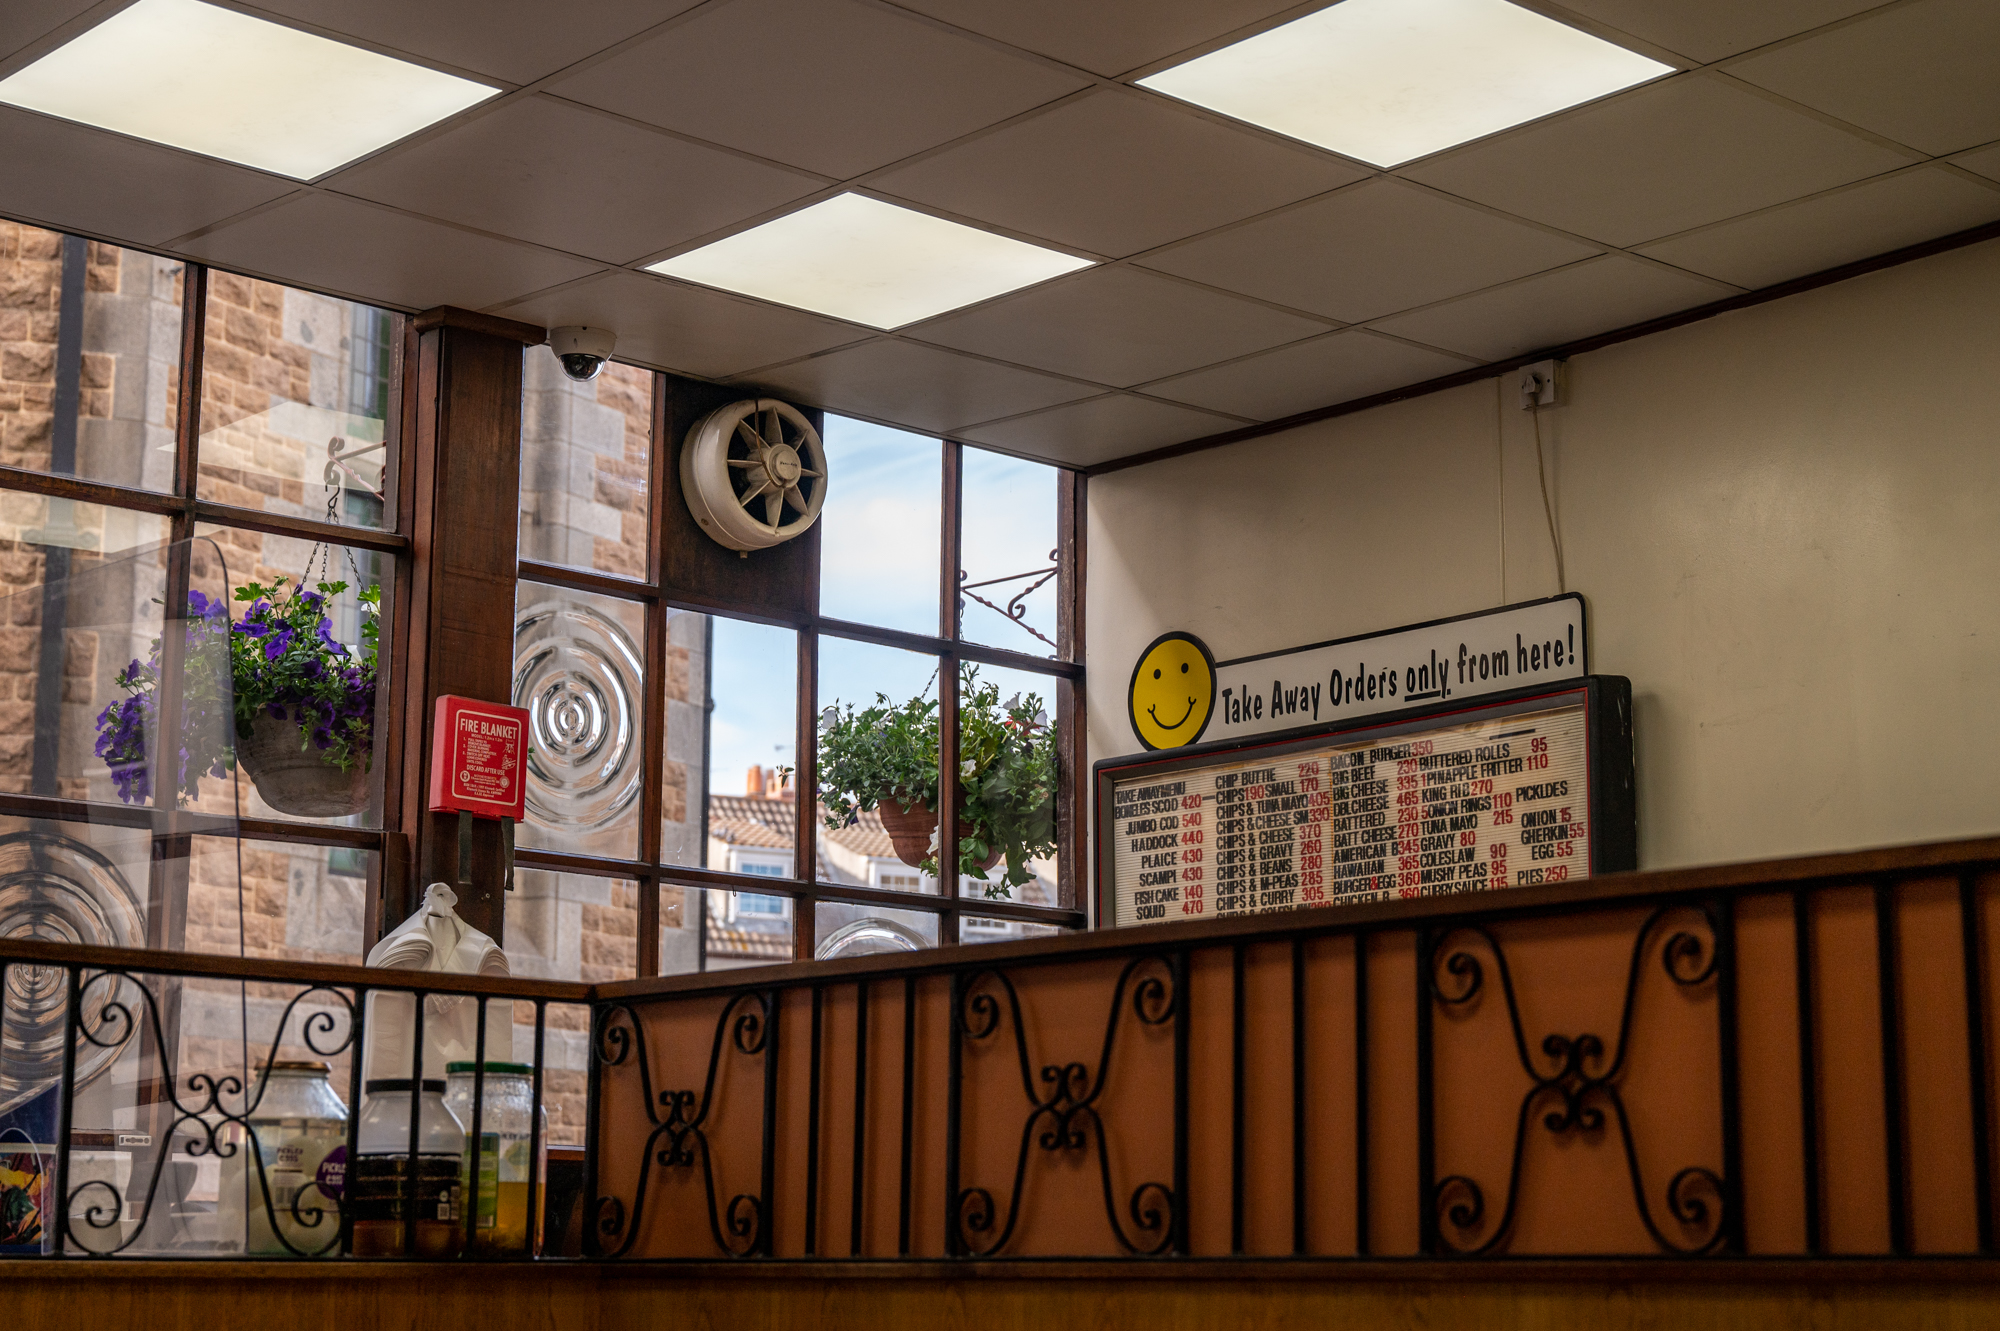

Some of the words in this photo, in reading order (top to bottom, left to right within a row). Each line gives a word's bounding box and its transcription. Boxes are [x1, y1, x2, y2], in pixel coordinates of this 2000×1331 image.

[1222, 688, 1262, 724] Take
[1271, 679, 1321, 721] Away
[1330, 662, 1397, 707] Orders
[1406, 649, 1450, 698] only
[1458, 643, 1508, 684] from
[1516, 624, 1575, 674] here!
[460, 718, 479, 733] FIRE
[481, 722, 517, 739] BLANKET
[1330, 751, 1364, 770] BACON
[1370, 744, 1411, 763] BURGER
[1412, 740, 1433, 756] 350
[1420, 750, 1471, 771] BUTTERED
[1476, 743, 1510, 762] ROLLS
[1531, 737, 1547, 753] 95
[1481, 758, 1523, 777] FRITTER
[1527, 753, 1548, 770] 110
[1216, 774, 1238, 789] CHIP
[1242, 768, 1276, 785] BUTTIE
[1298, 762, 1319, 777] 220
[1332, 770, 1349, 785] BIG
[1351, 765, 1375, 782] BEEF
[1397, 759, 1417, 775] 230
[1116, 789, 1136, 804] TAKE
[1216, 789, 1245, 804] CHIPS
[1245, 785, 1265, 800] 190
[1265, 781, 1297, 797] SMALL
[1300, 778, 1318, 792] 170
[1333, 786, 1349, 801] BIG
[1351, 779, 1388, 798] CHEESE
[1397, 774, 1418, 791] 335
[1397, 790, 1418, 806] 465
[1422, 785, 1446, 803] KING
[1450, 783, 1470, 798] RIB
[1471, 779, 1493, 796] 270
[1181, 794, 1201, 809] 420
[1216, 803, 1245, 819] CHIPS
[1246, 801, 1254, 815] &
[1256, 798, 1281, 814] TUNA
[1282, 794, 1308, 810] MAYO
[1309, 791, 1330, 806] 405
[1428, 801, 1458, 818] ONION
[1461, 794, 1491, 813] RINGS
[1492, 792, 1512, 809] 110
[1126, 819, 1156, 835] JUMBO
[1160, 816, 1179, 830] COD
[1182, 813, 1202, 827] 540
[1216, 818, 1245, 835] CHIPS
[1247, 816, 1255, 830] &
[1256, 812, 1291, 829] CHEESE
[1294, 810, 1309, 825] SM
[1309, 807, 1329, 822] 330
[1334, 812, 1385, 832] BATTERED
[1398, 807, 1418, 823] 230
[1420, 819, 1447, 835] TUNA
[1450, 814, 1478, 832] MAYO
[1493, 809, 1513, 825] 215
[1521, 809, 1557, 828] ONION
[1560, 807, 1571, 823] 15
[1132, 834, 1178, 852] HADDOCK
[1181, 830, 1203, 845] 440
[1216, 834, 1245, 849] CHIPS
[1248, 832, 1255, 846] &
[1259, 827, 1295, 845] CHEESE
[1299, 824, 1321, 839] 370
[1334, 832, 1359, 848] BATT
[1362, 826, 1397, 844] CHEESE
[1398, 823, 1418, 839] 270
[1420, 833, 1455, 852] GRAVY
[1460, 830, 1475, 846] 80
[1521, 824, 1568, 845] GHERKIN
[1569, 822, 1585, 839] 55
[1142, 852, 1177, 869] PLAICE
[1182, 849, 1203, 863] 430
[1216, 849, 1245, 865] CHIPS
[1249, 848, 1255, 861] &
[1260, 843, 1293, 860] GRAVY
[1300, 839, 1322, 855] 260
[1334, 843, 1386, 864] AMERICAN
[1392, 842, 1398, 856] B
[1398, 839, 1420, 855] 345
[1420, 847, 1475, 868] COLESLAW
[1490, 843, 1507, 859] 90
[1532, 844, 1554, 860] EGG
[1557, 841, 1573, 858] 55
[1139, 870, 1176, 887] SCAMPI
[1182, 867, 1203, 881] 430
[1217, 864, 1246, 880] CHIPS
[1249, 863, 1256, 876] &
[1260, 859, 1292, 875] BEANS
[1301, 855, 1322, 870] 280
[1334, 860, 1384, 879] HAWAIIAN
[1398, 855, 1419, 871] 365
[1398, 871, 1420, 887] 360
[1421, 866, 1455, 884] MUSHY
[1459, 863, 1487, 879] PEAS
[1491, 860, 1507, 876] 95
[1517, 869, 1543, 885] PIES
[1545, 865, 1567, 883] 250
[1135, 891, 1153, 905] FISH
[1156, 888, 1179, 903] CAKE
[1183, 885, 1203, 899] 140
[1216, 880, 1246, 896] CHIPS
[1249, 878, 1256, 892] &
[1261, 874, 1298, 890] M-PEAS
[1301, 871, 1323, 886] 285
[1489, 876, 1508, 890] 115
[1136, 904, 1165, 919] SQUID
[1182, 900, 1203, 914] 470
[1216, 895, 1246, 911] CHIPS
[1249, 894, 1256, 907] &
[1261, 889, 1294, 906] CURRY
[1302, 886, 1323, 901] 305
